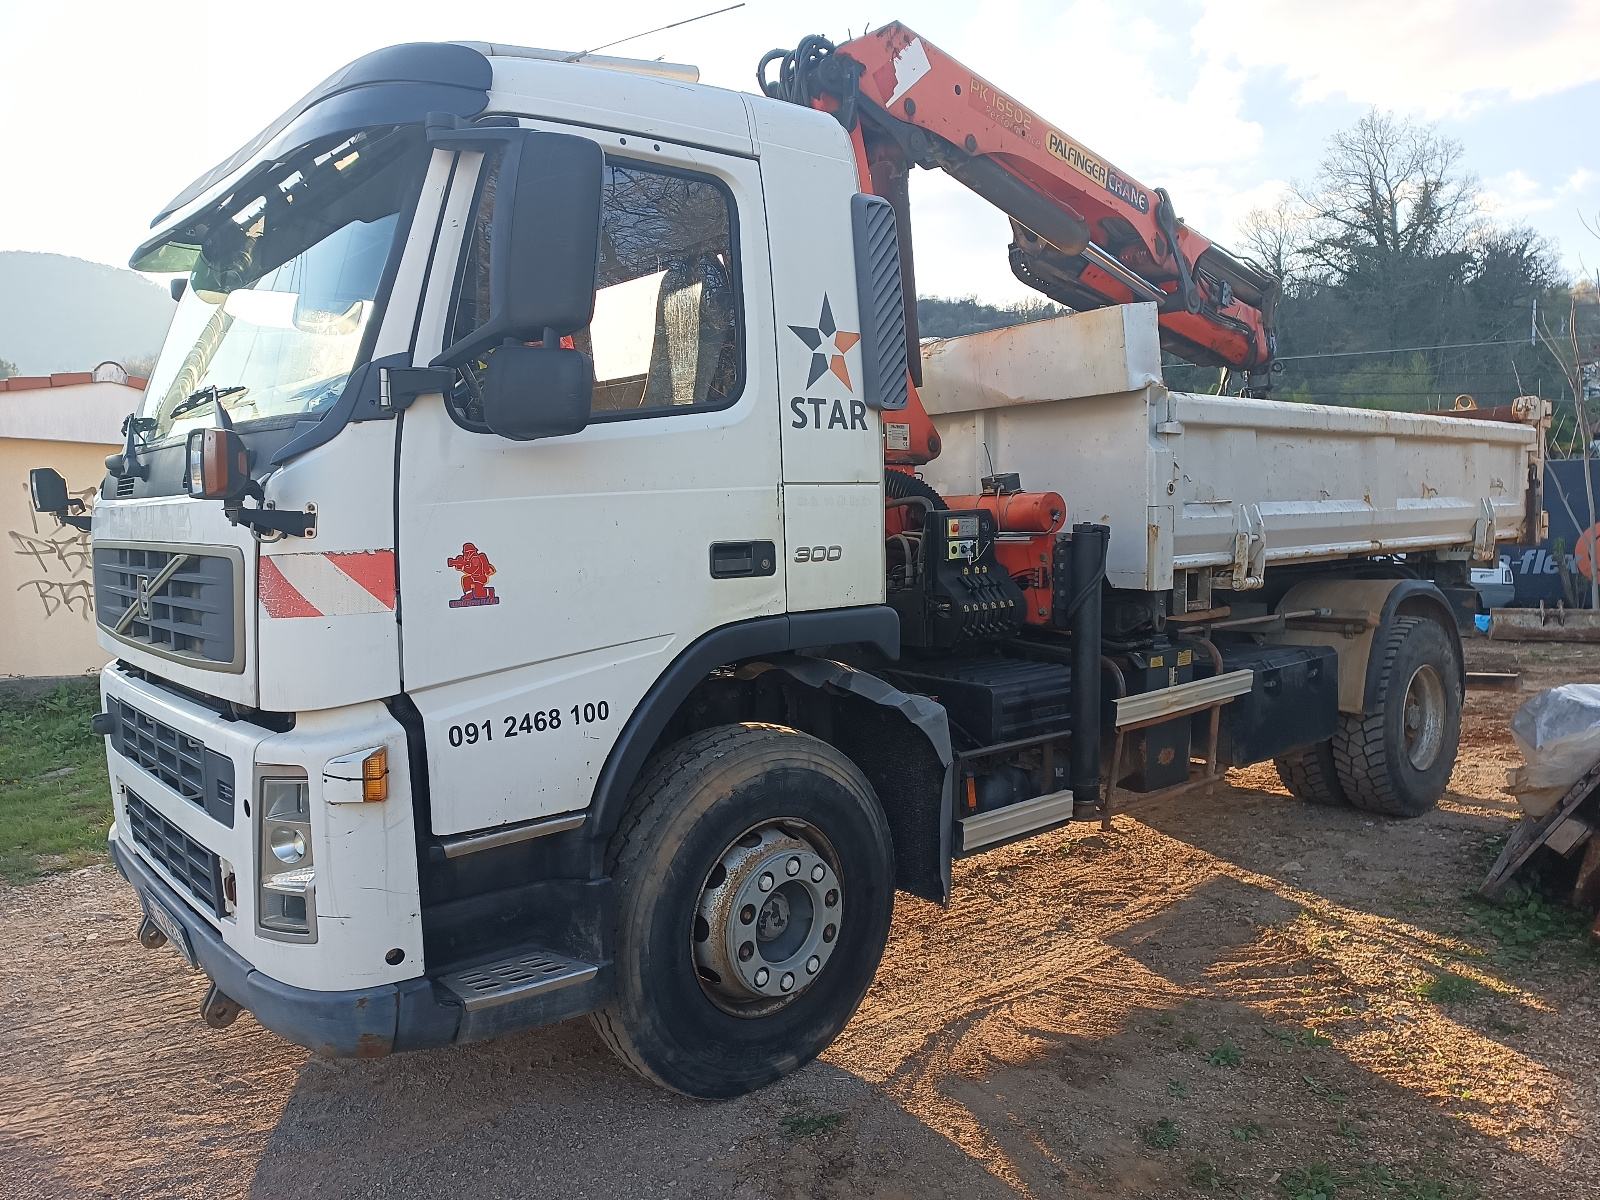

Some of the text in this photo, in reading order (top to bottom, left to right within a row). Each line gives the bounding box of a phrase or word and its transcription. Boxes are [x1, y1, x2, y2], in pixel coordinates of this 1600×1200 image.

[970, 78, 1032, 130] PK 16502
[986, 105, 1041, 145] Performnce
[1049, 133, 1146, 209] PALFINGER CRANE
[790, 396, 868, 430] STAR
[794, 545, 842, 563] 300
[448, 700, 609, 747] 091 2468 100
